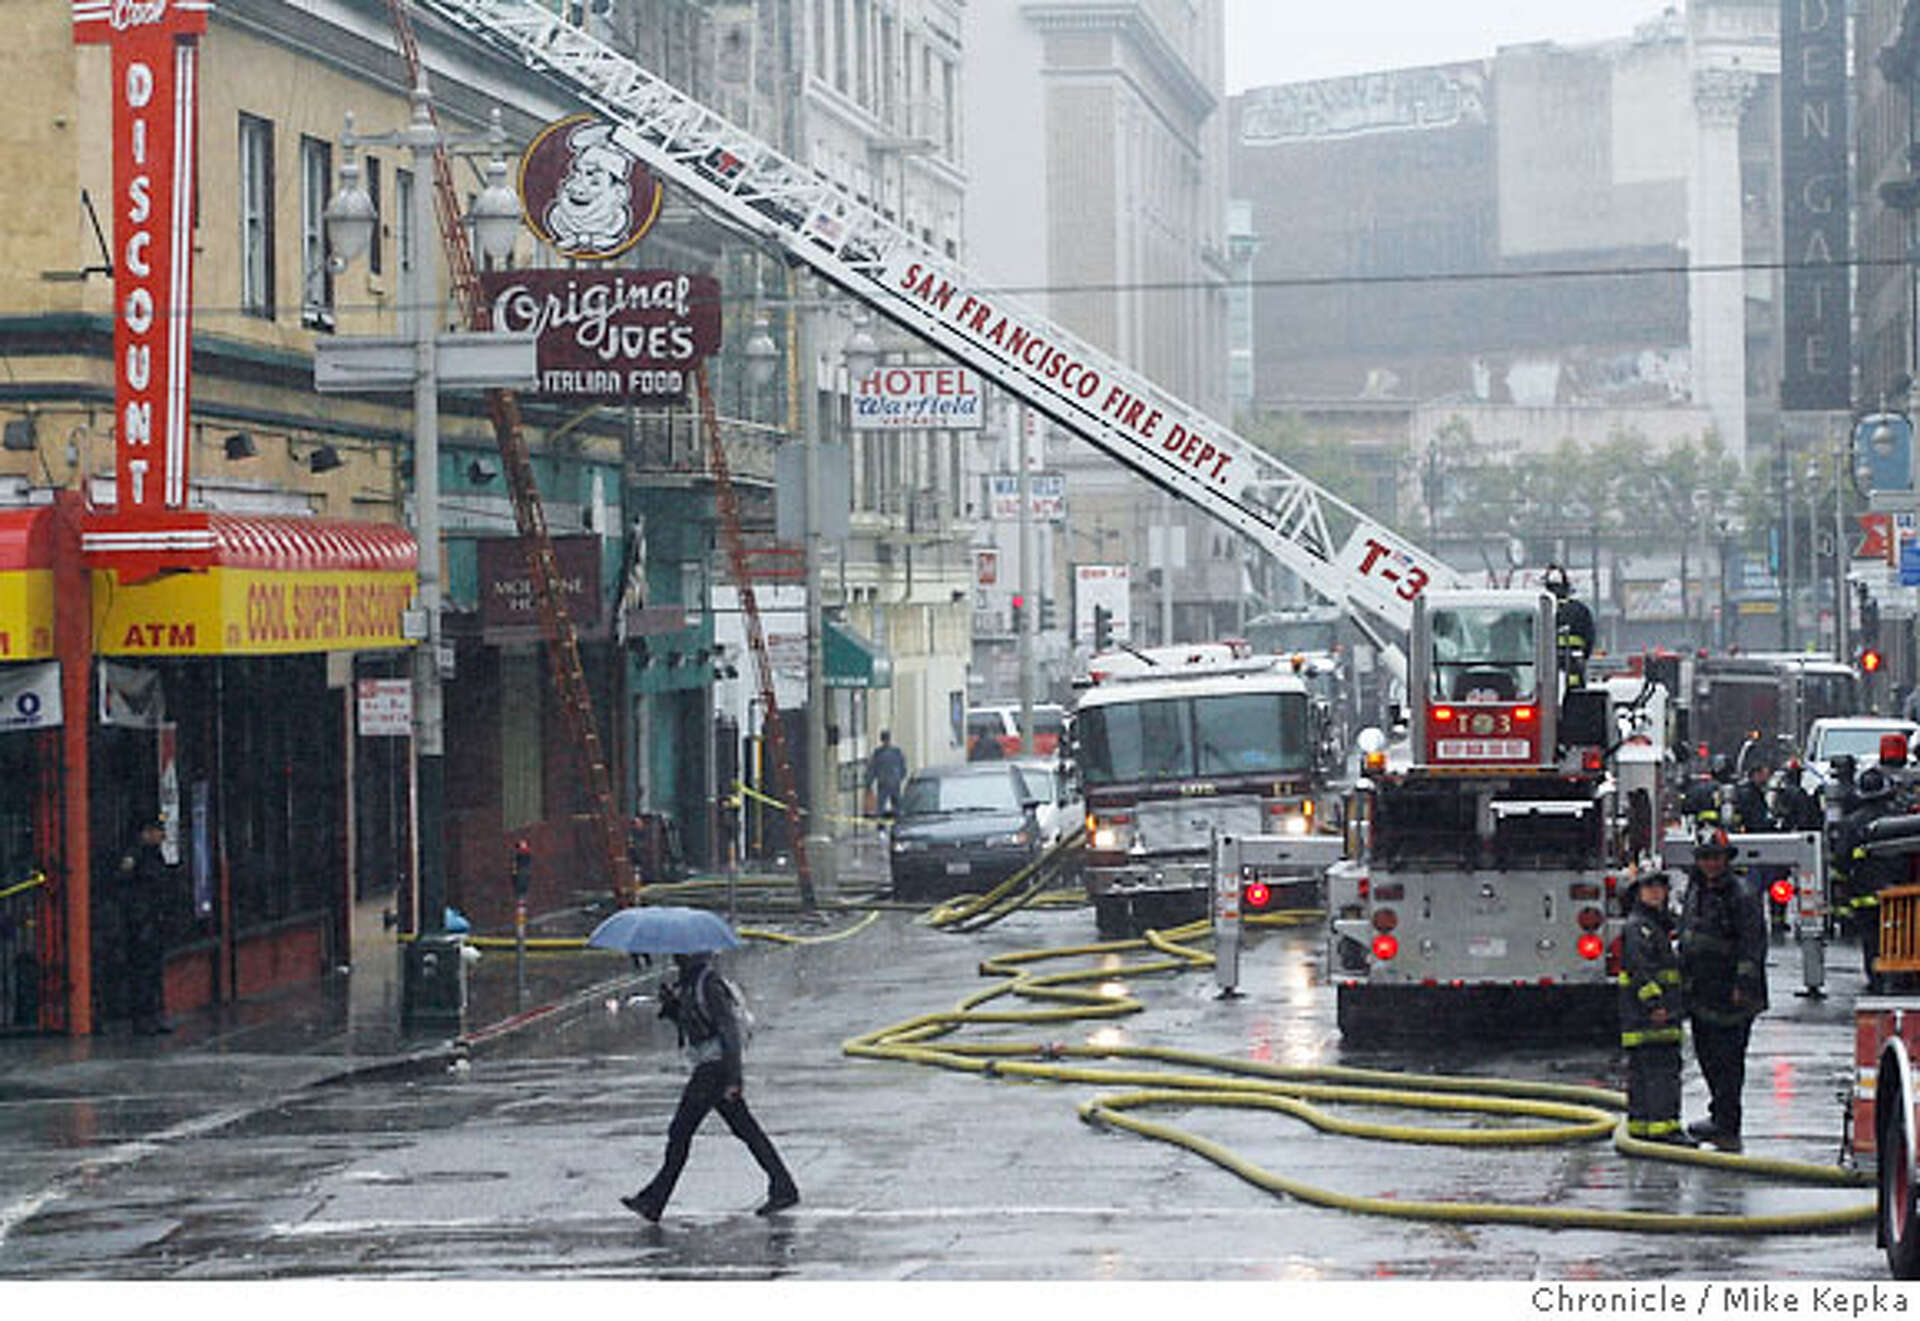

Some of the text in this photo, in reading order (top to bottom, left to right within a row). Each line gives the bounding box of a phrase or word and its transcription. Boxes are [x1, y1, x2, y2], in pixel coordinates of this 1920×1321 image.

[125, 61, 154, 504] DISCOUNT
[493, 275, 690, 347] Original
[598, 321, 694, 360] JOE'S
[542, 369, 683, 393] ITALIAN FOOD
[860, 369, 975, 396] HOTEL
[900, 263, 958, 313] SAN
[956, 297, 1100, 399] FRANCISCO
[1102, 386, 1163, 438] FIRE
[1161, 423, 1233, 485] DEPT.
[855, 396, 978, 417] Warfield
[1359, 539, 1430, 602] T-3
[124, 623, 196, 647] ATM
